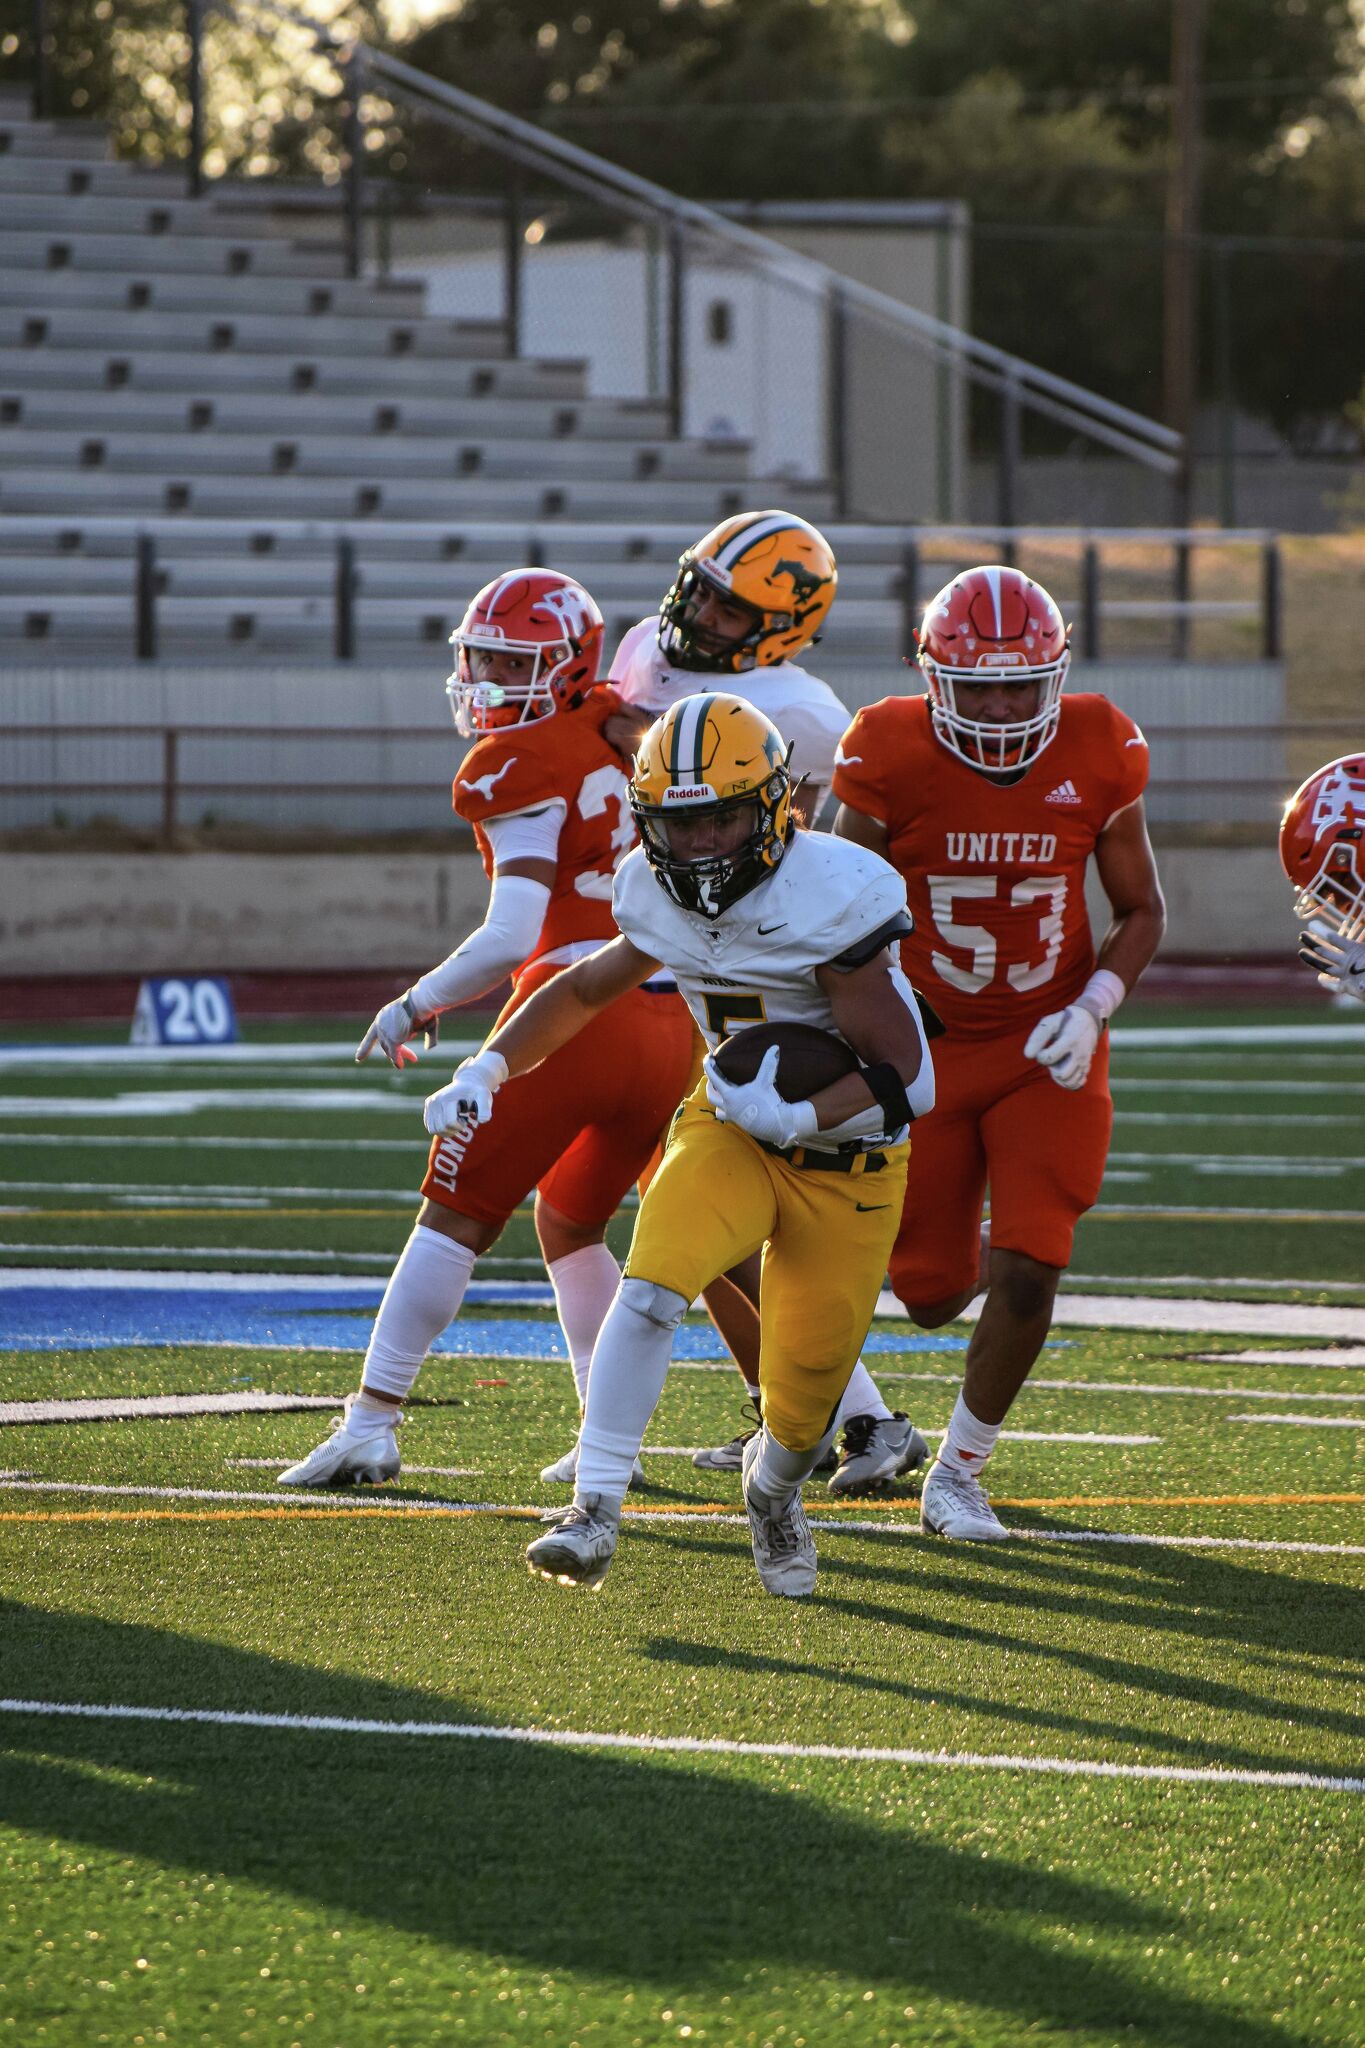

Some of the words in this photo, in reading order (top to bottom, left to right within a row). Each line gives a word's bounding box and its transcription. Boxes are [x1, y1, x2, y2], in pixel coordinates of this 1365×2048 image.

[667, 786, 708, 799] Riddell
[1044, 794, 1082, 804] adidas
[946, 832, 1057, 863] UNITED
[927, 874, 1069, 994] 53
[160, 979, 228, 1041] 20
